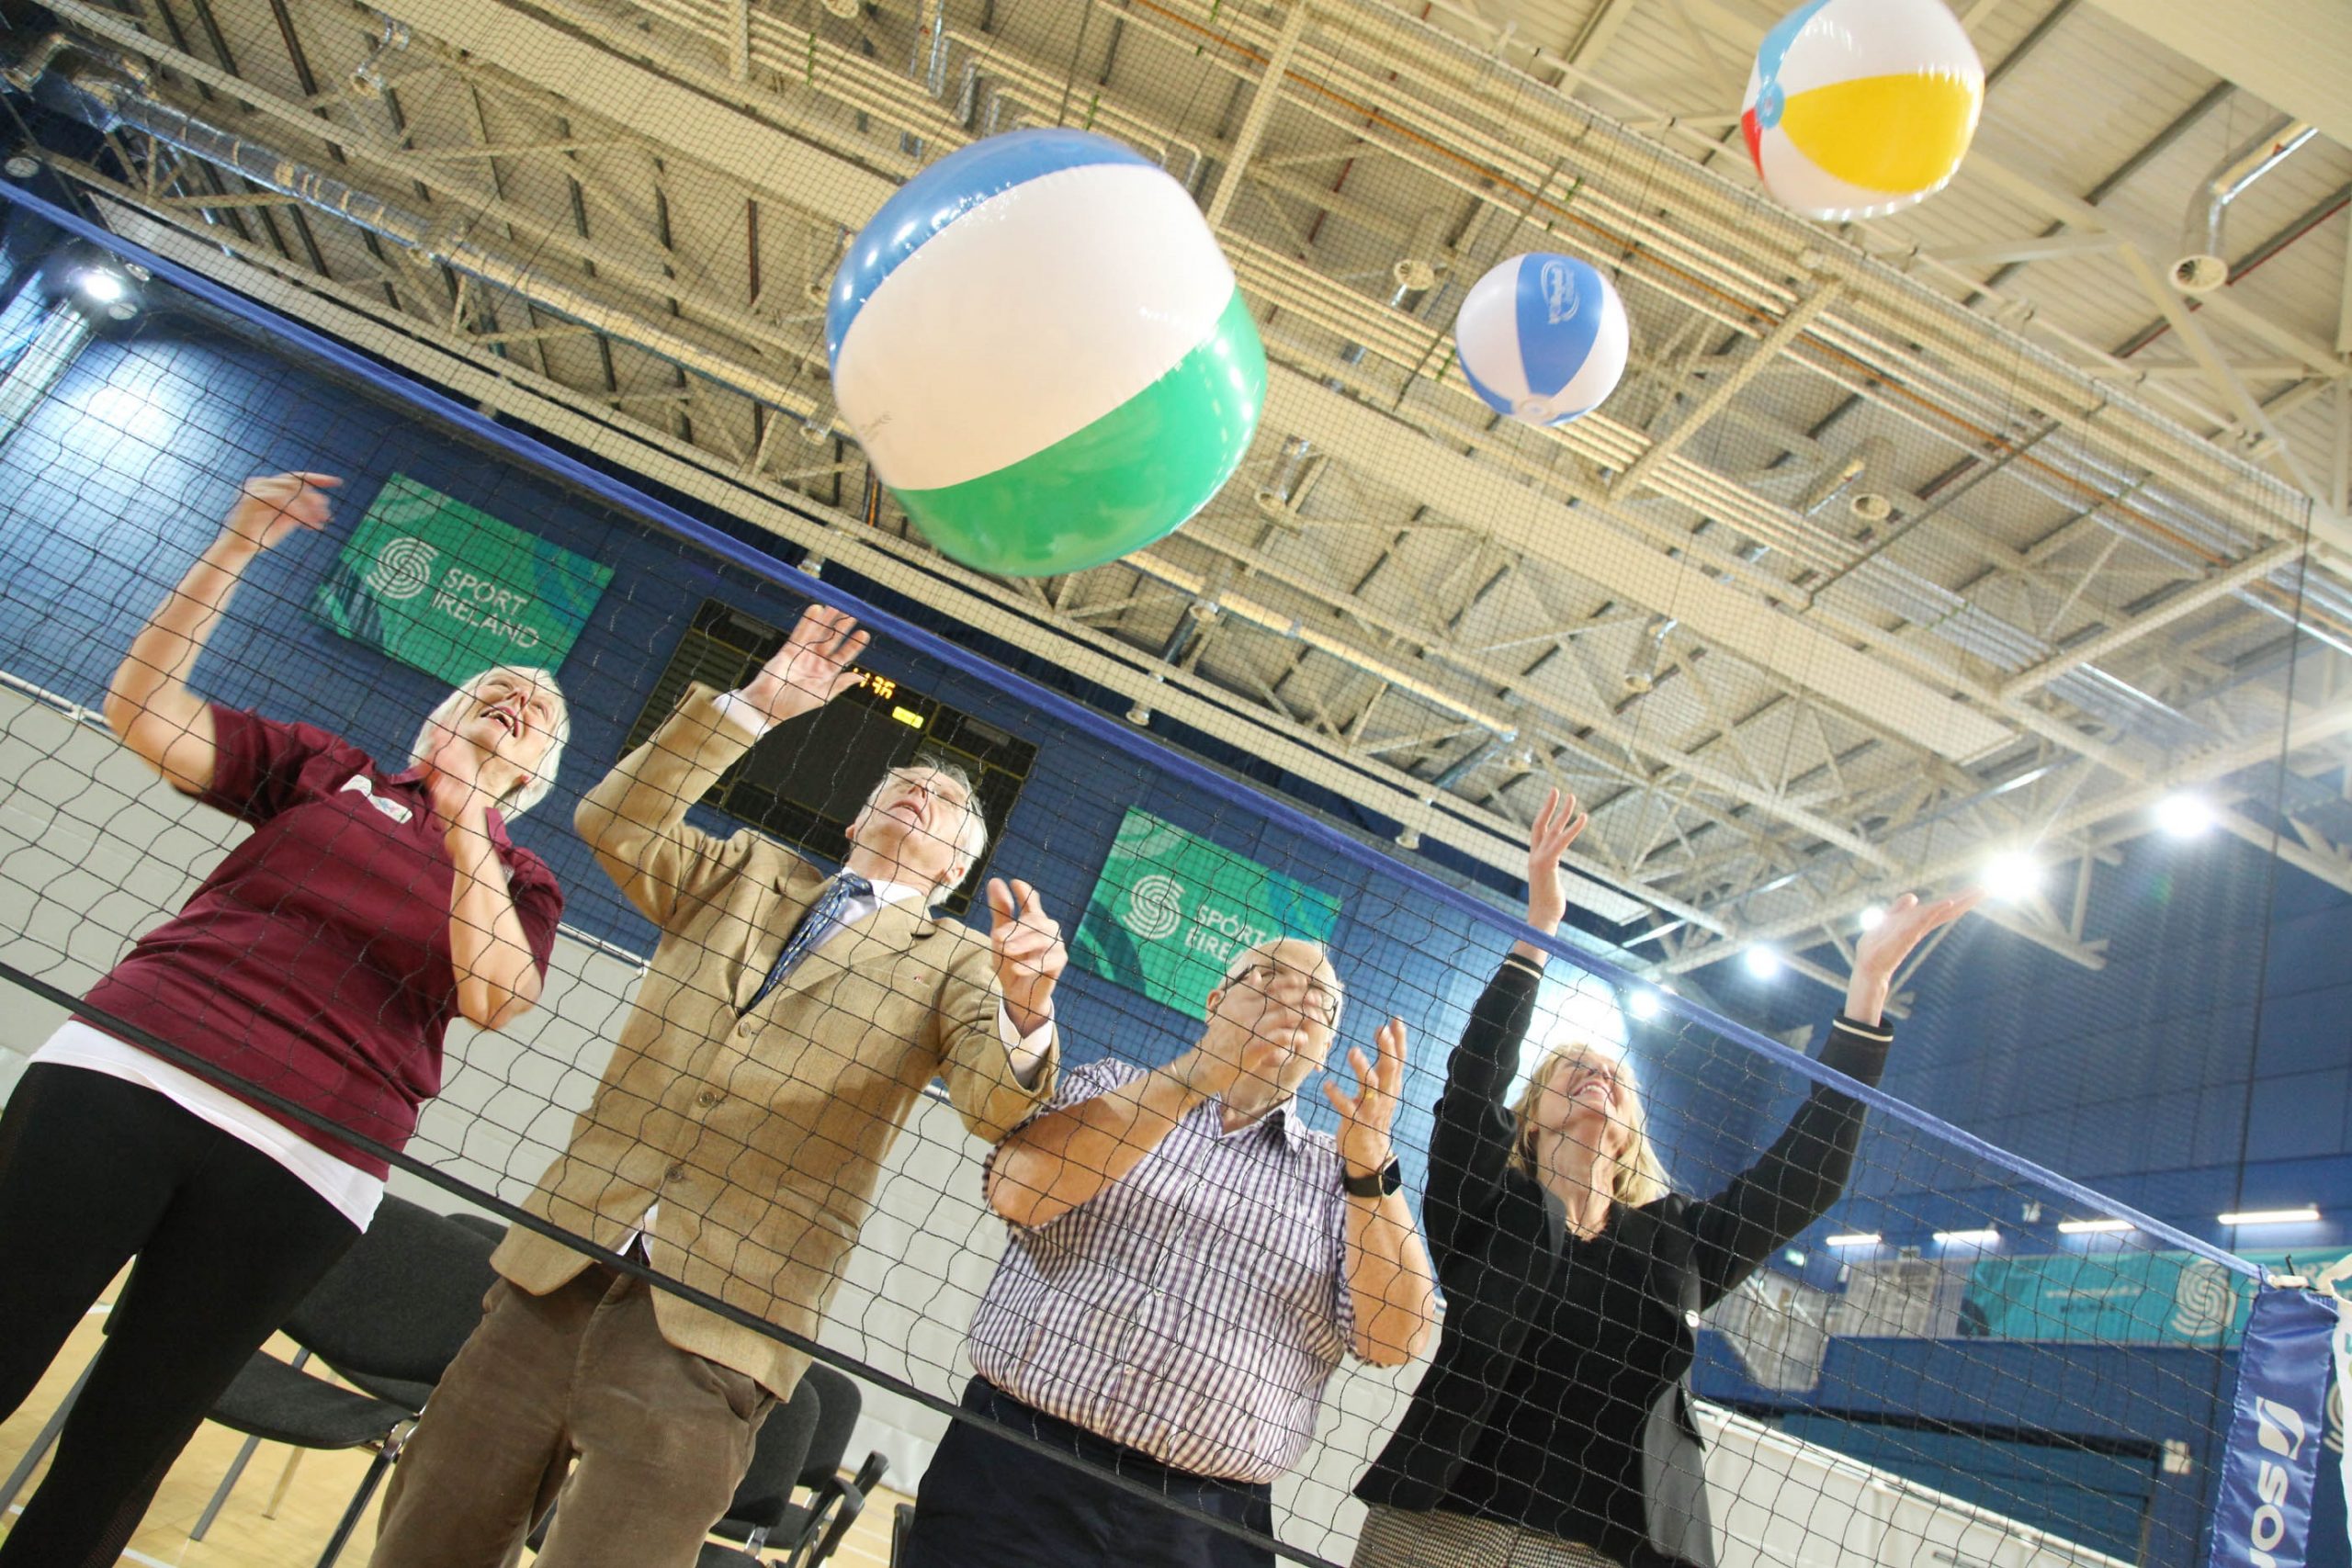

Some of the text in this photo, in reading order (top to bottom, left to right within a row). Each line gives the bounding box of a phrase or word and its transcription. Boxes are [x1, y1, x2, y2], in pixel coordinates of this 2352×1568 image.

[443, 569, 528, 615] SPORT
[432, 591, 539, 648] IRELAND
[1195, 906, 1265, 948] SPÓRT
